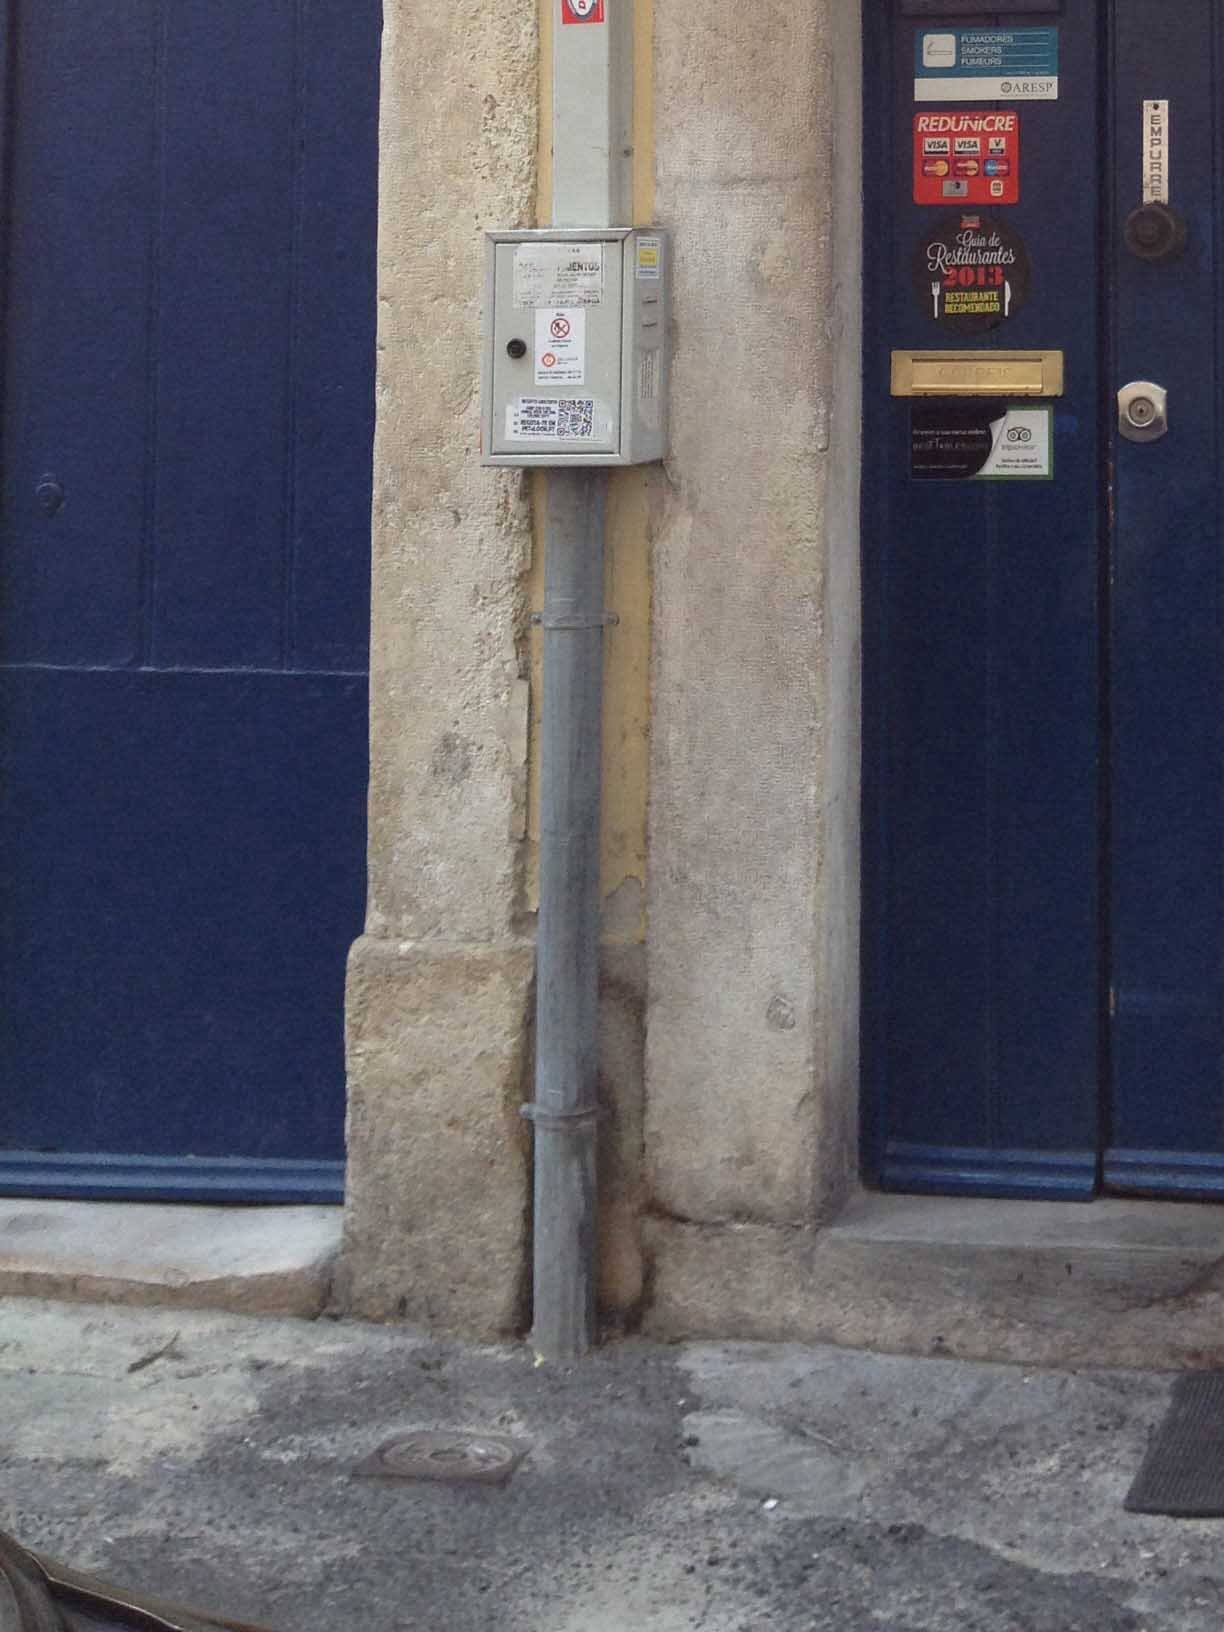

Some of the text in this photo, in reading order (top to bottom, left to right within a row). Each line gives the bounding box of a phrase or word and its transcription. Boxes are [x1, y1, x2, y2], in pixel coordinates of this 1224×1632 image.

[960, 35, 1014, 44] FUMADORES
[960, 46, 1003, 55] SMOKERS
[960, 57, 1003, 66] FUMEURS
[926, 140, 948, 149] VISA
[956, 140, 978, 149] VISA
[1149, 114, 1162, 197] EMPURRE
[988, 232, 1001, 247] de
[926, 242, 1016, 274] Restaurantes
[944, 266, 1004, 287] 2013
[945, 291, 999, 303] RESTAURANTE
[944, 302, 1000, 314] RECOMENDADO
